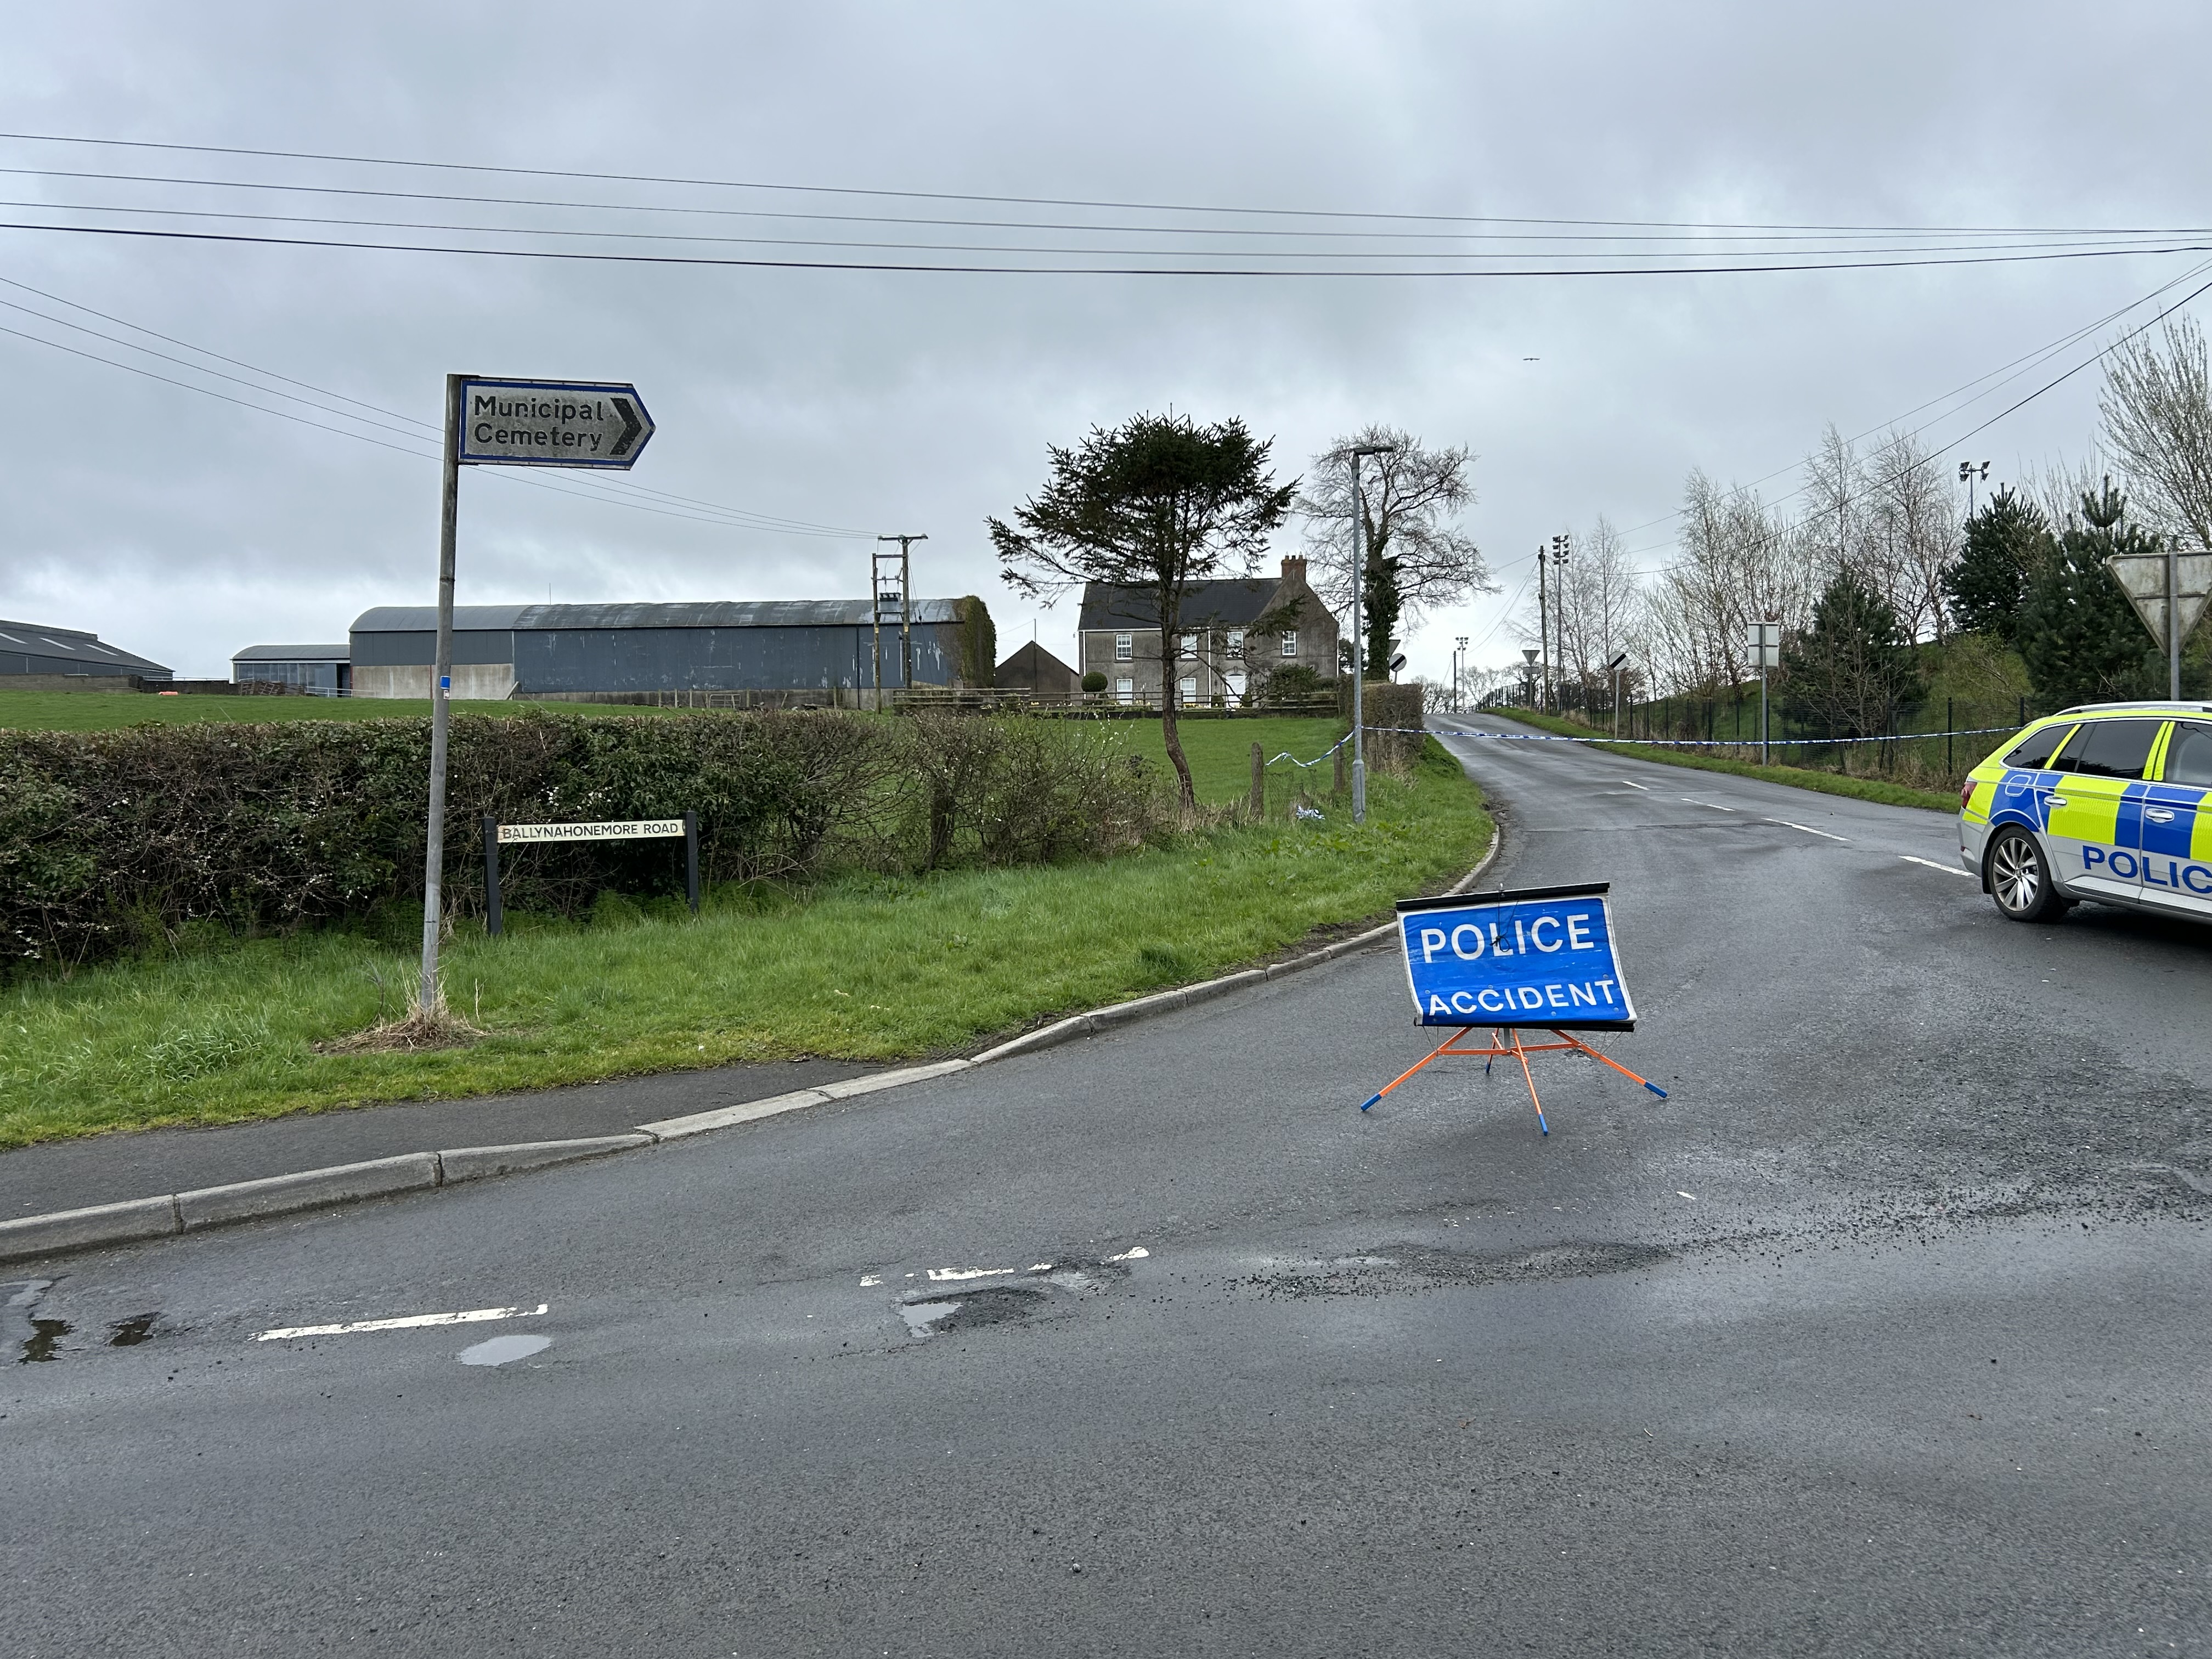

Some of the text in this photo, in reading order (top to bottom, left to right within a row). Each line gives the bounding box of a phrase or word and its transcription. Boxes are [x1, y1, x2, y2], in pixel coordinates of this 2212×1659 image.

[475, 396, 604, 424] Municipal
[474, 422, 602, 452] Cemetery
[503, 823, 679, 839] BALLYNAHONEMORE ROAD
[1420, 914, 1594, 963] POLICE
[1429, 980, 1615, 1016] ACCIDENT
